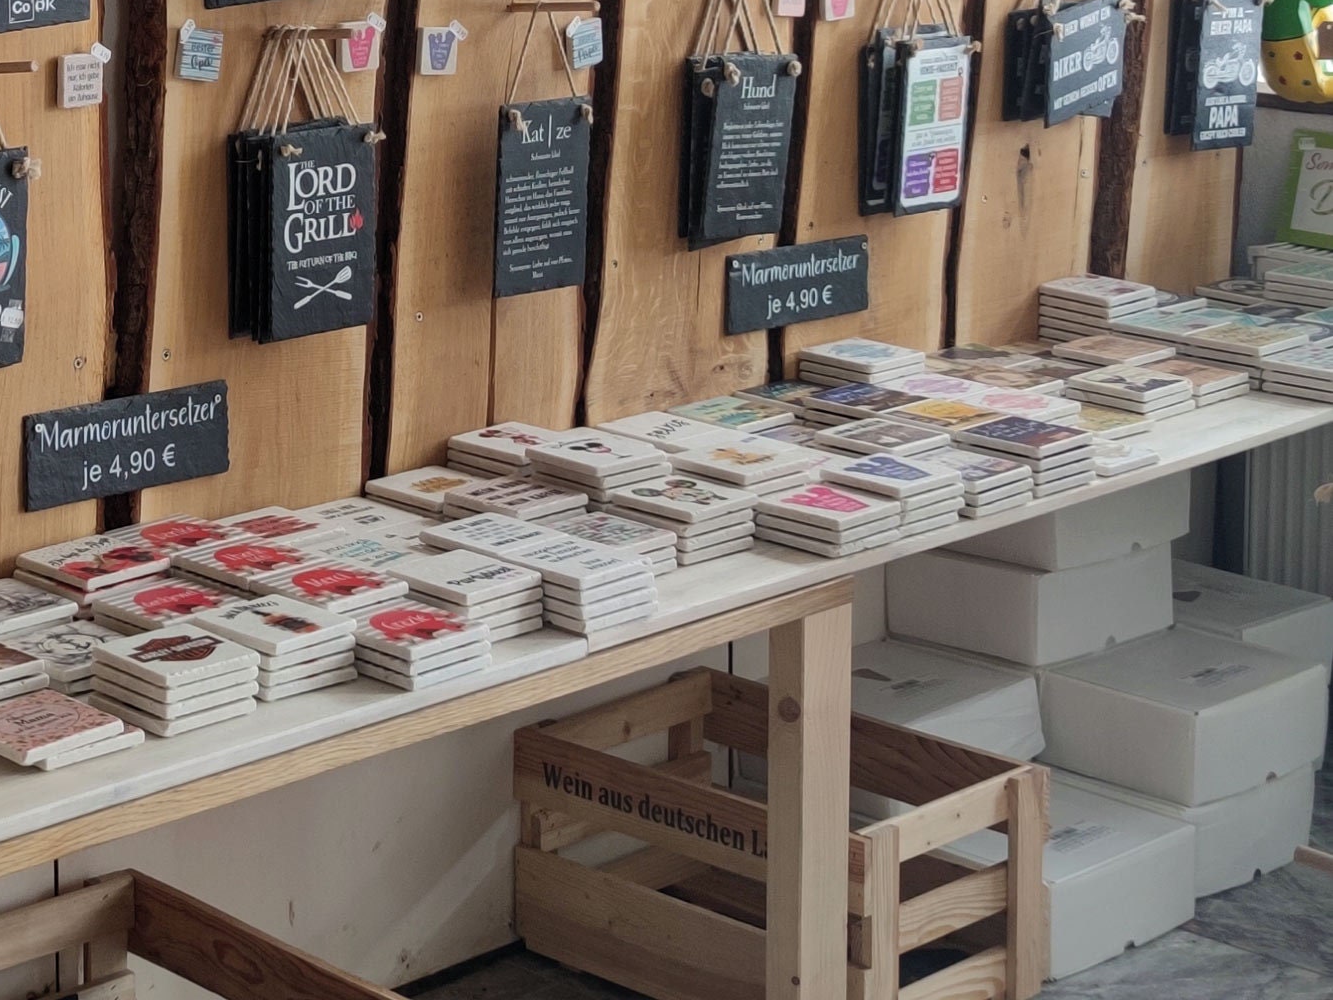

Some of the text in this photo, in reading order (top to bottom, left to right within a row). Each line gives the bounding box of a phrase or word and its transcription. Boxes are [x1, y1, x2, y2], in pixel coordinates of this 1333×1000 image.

[741, 74, 776, 99] Hund
[286, 162, 356, 212] LORD
[303, 194, 356, 216] OF THE
[283, 212, 356, 254] GRILL
[741, 248, 860, 287] Marmoruntersetzer
[766, 285, 833, 320] je 4,90 €
[40, 396, 217, 453] Marmoruntersetzer
[82, 443, 176, 491] je 4,90 €
[542, 762, 745, 851] Wein aus deutschen
